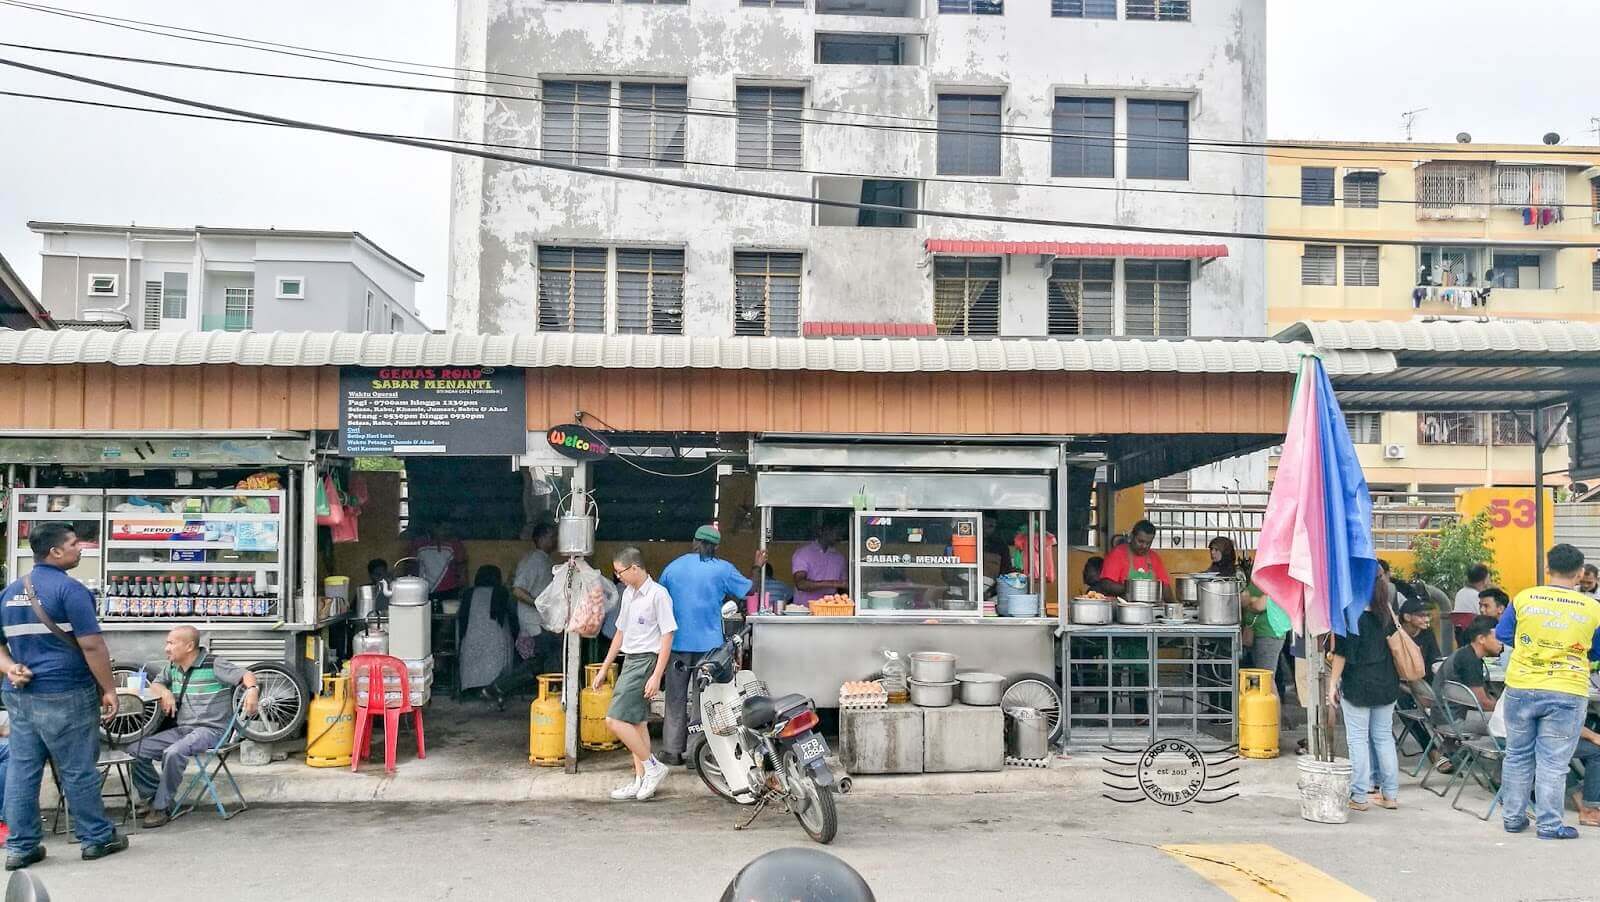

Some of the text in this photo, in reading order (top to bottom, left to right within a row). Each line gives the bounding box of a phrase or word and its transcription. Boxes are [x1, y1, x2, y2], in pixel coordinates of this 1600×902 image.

[379, 368, 436, 379] GEMAS
[441, 368, 481, 379] ROAD
[372, 380, 493, 390] SABAR MENANTI
[420, 412, 449, 420] hingga
[1489, 499, 1536, 529] 53
[866, 555, 961, 564] SABAR MENANTI
[800, 738, 819, 753] PFB
[803, 744, 825, 760] 4284
